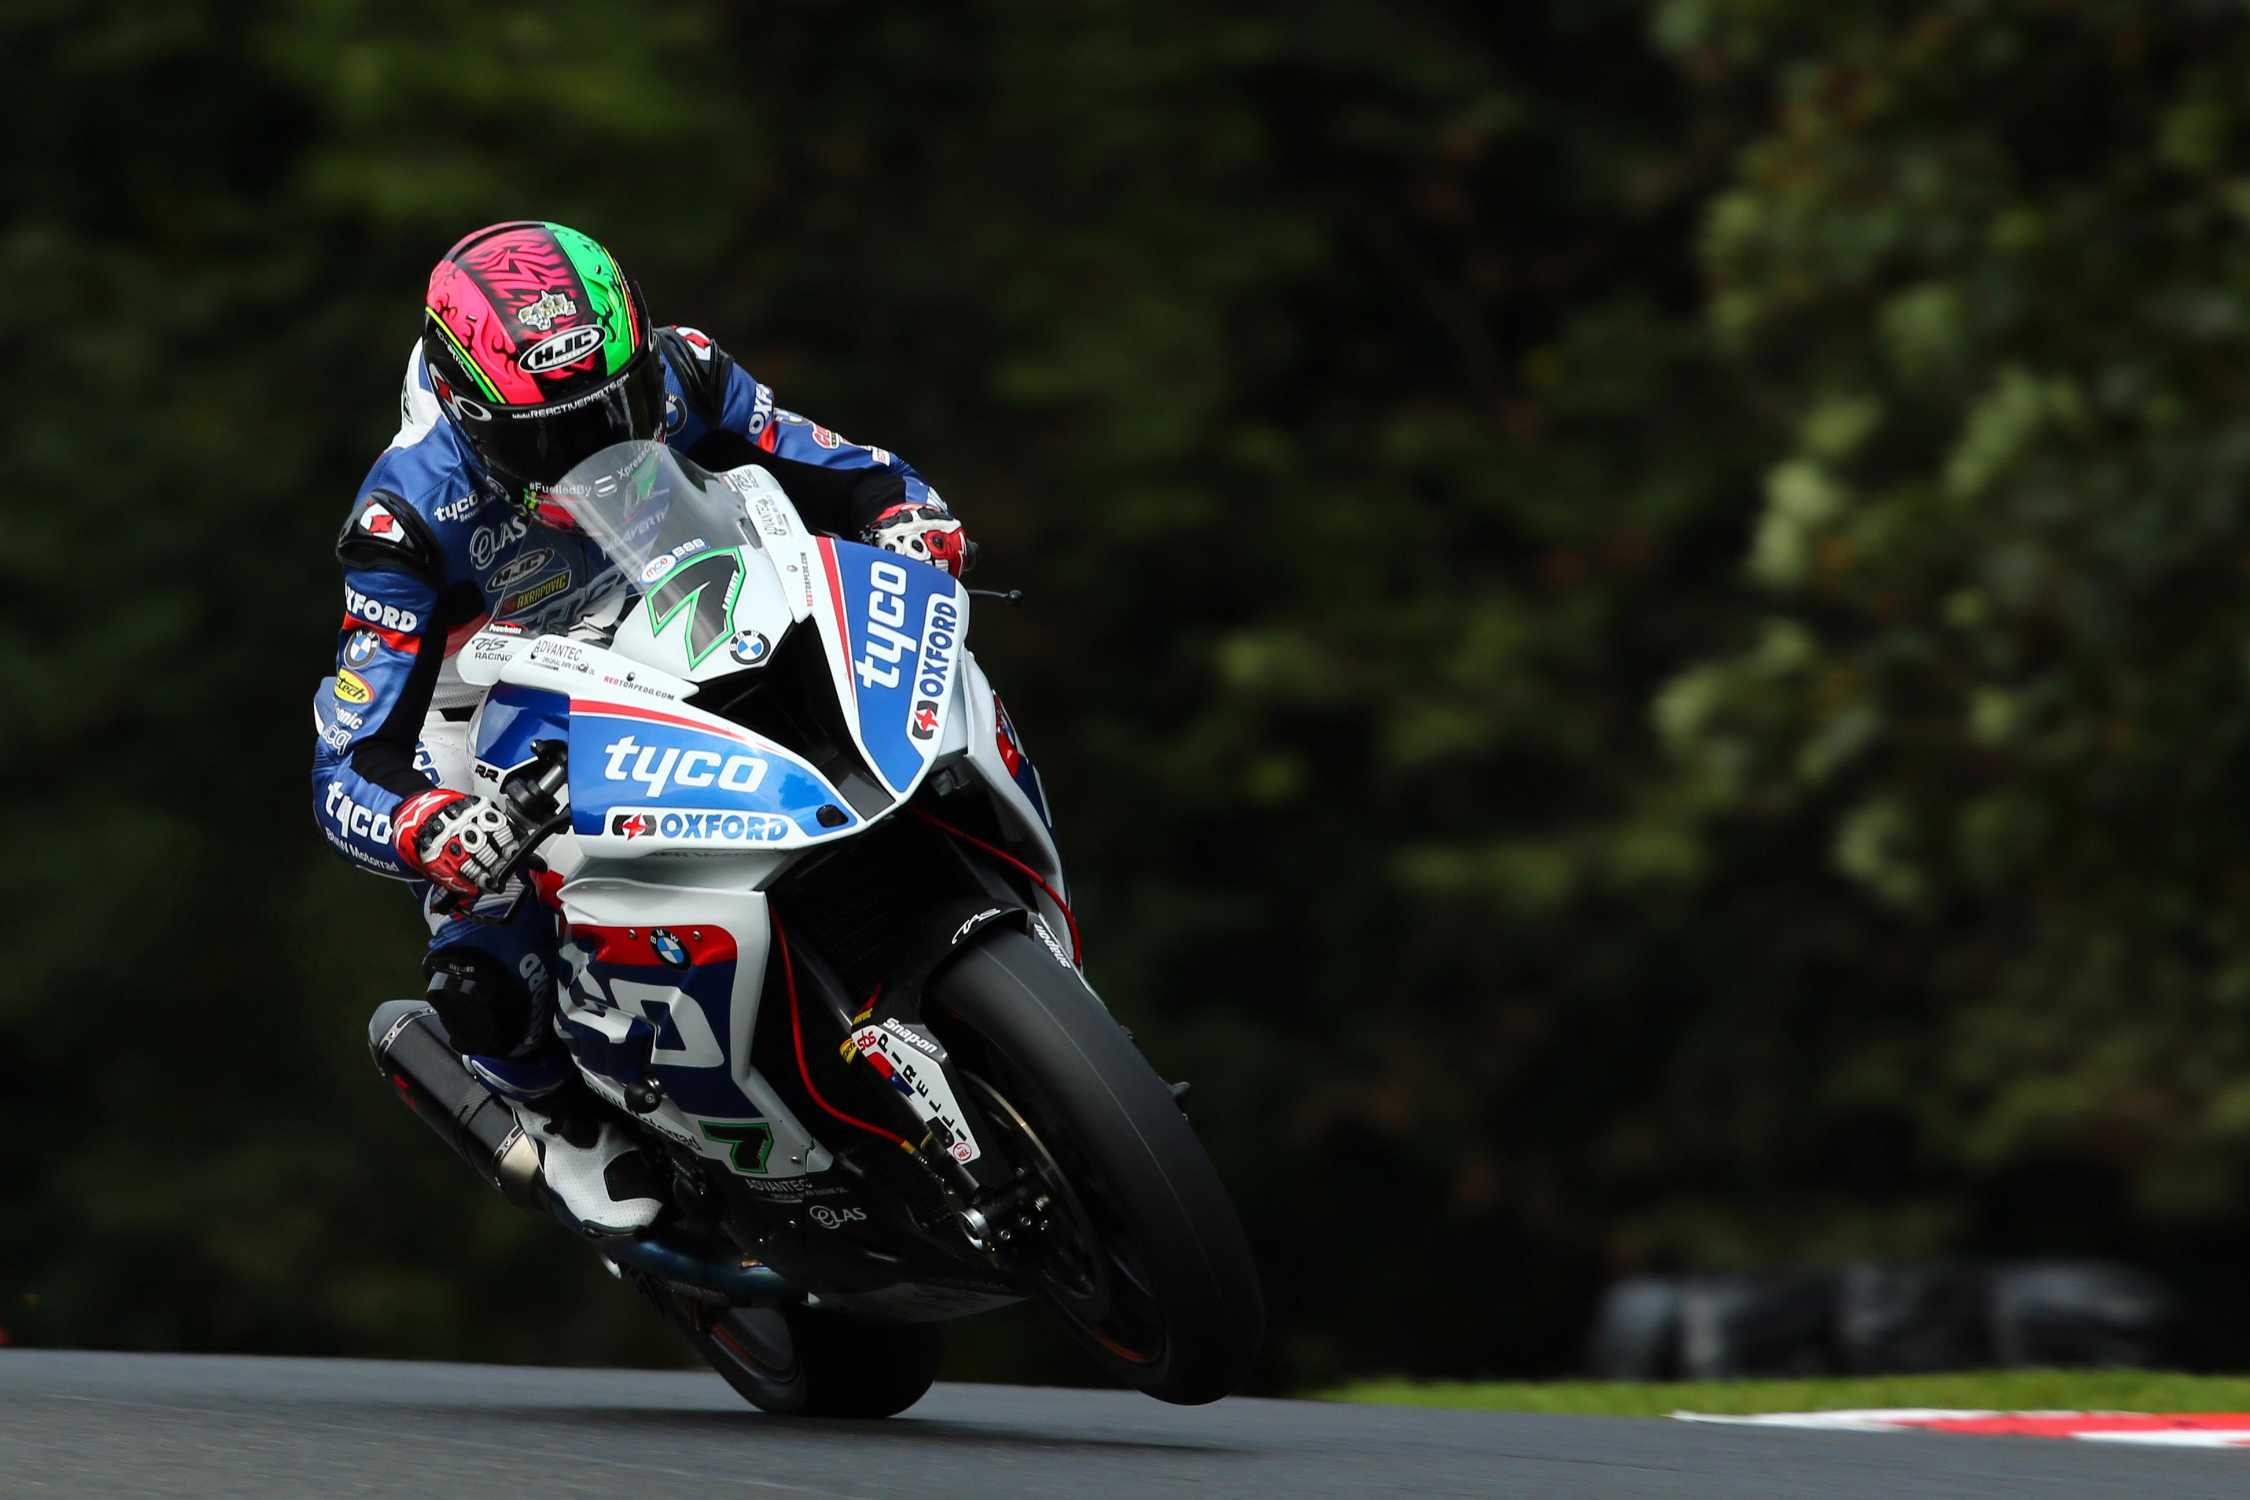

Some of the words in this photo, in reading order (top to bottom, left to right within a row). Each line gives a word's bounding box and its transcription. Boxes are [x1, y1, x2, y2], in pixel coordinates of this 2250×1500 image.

[534, 330, 593, 367] HJC
[434, 490, 479, 522] tyco
[645, 545, 746, 671] 7
[855, 560, 916, 690] tyco
[474, 652, 514, 664] RACING
[919, 601, 958, 698] OXFORD
[475, 763, 500, 783] RR
[604, 735, 769, 798] tyco
[325, 781, 394, 845] tyco
[660, 813, 789, 842] OXFORD
[883, 1017, 938, 1054] Snap-on
[877, 1033, 967, 1141] PIRELLI
[698, 1119, 774, 1174] 7
